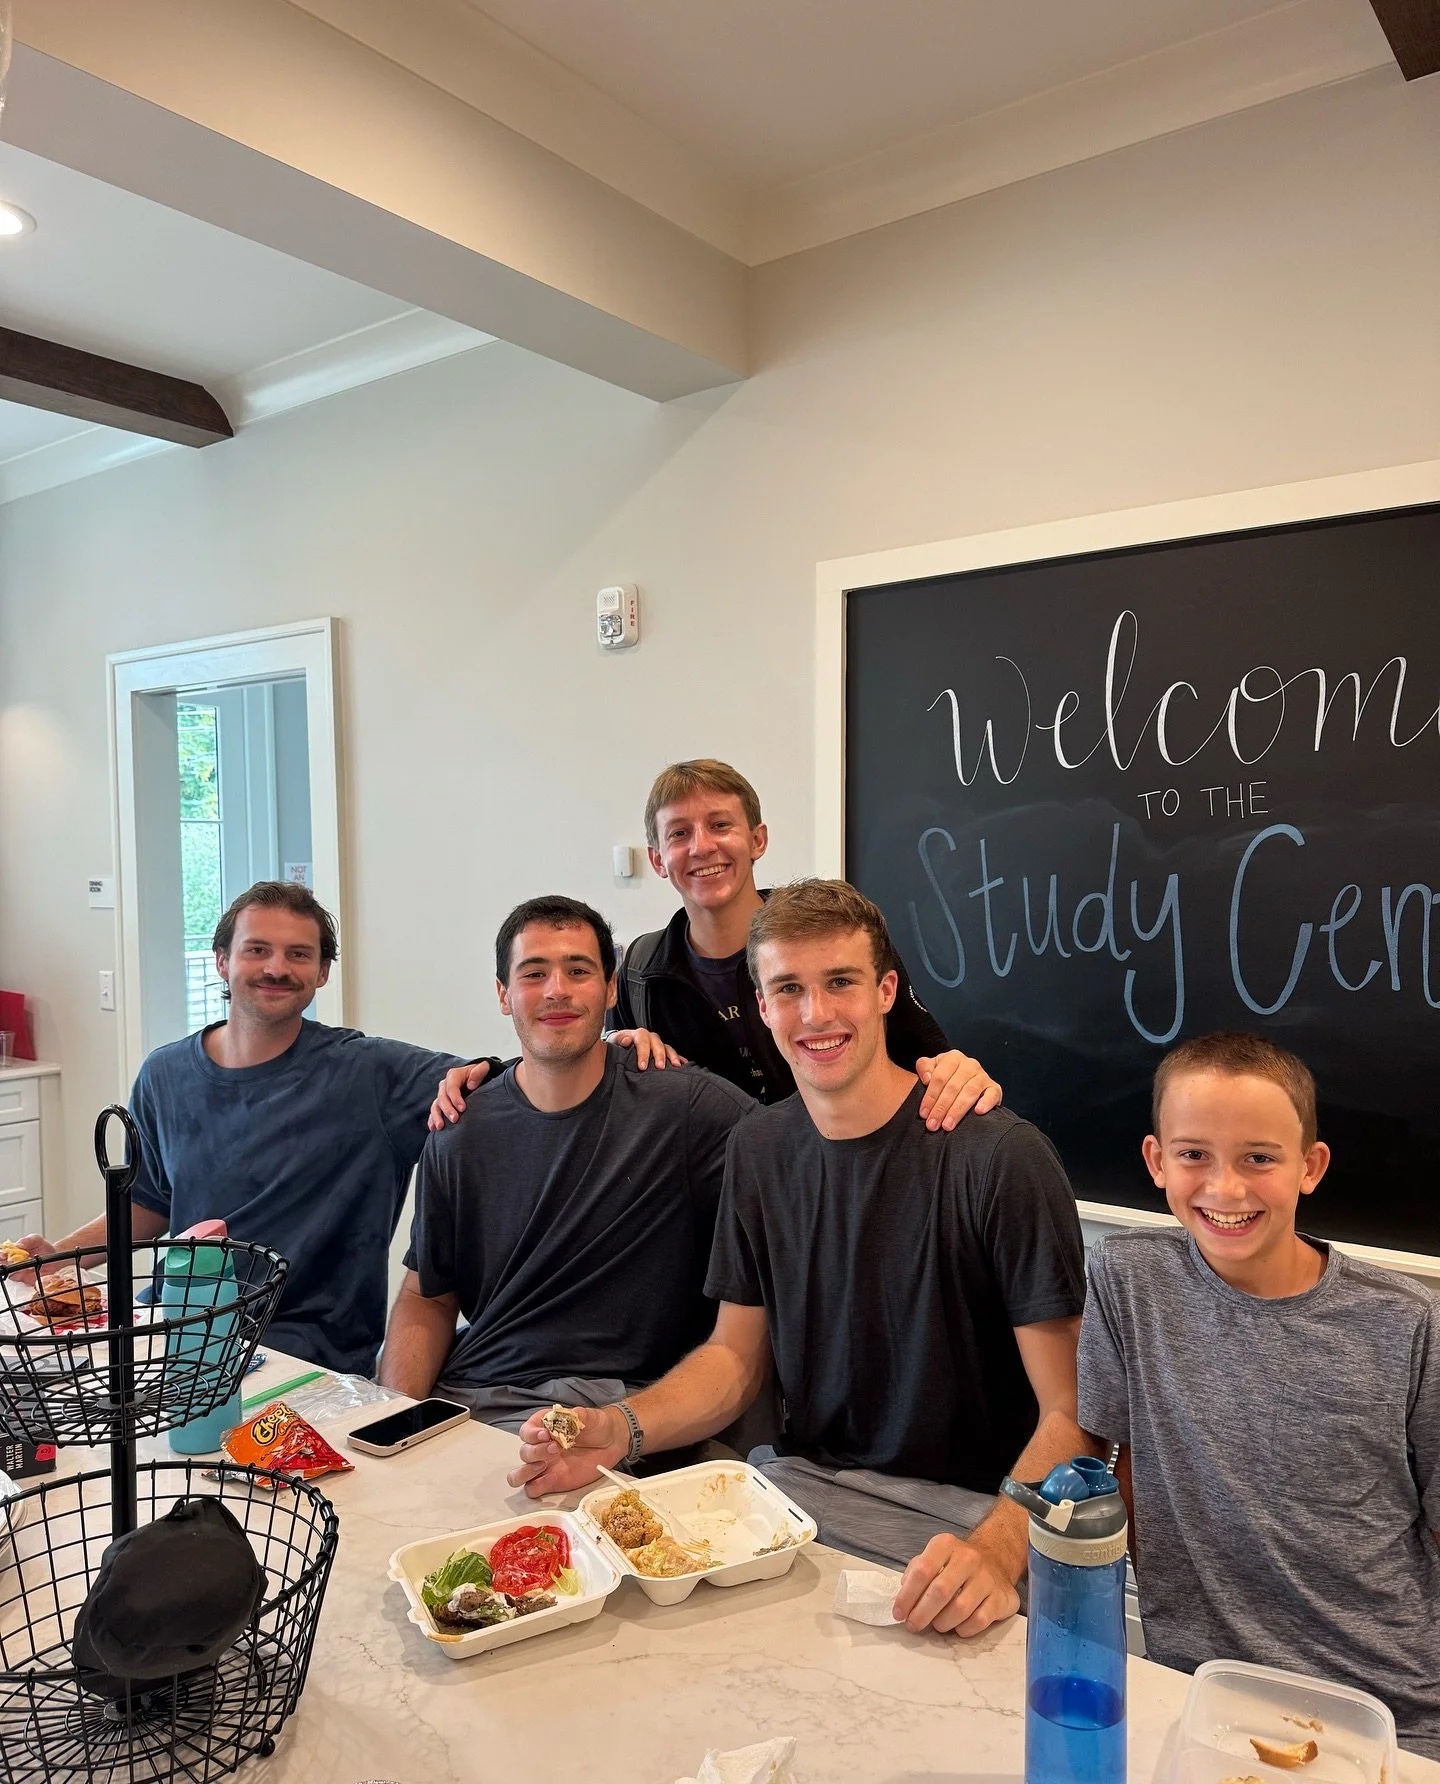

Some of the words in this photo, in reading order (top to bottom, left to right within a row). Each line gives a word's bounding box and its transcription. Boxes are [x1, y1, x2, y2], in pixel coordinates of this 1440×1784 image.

[1137, 787, 1180, 820] TO
[1199, 780, 1270, 819] THE
[291, 865, 306, 873] NOT
[908, 822, 1185, 1045] Study
[1229, 823, 1440, 1016] Cen
[252, 1402, 296, 1445] Cheet
[6, 1444, 15, 1472] WALTER
[15, 1443, 24, 1469] MARTIN
